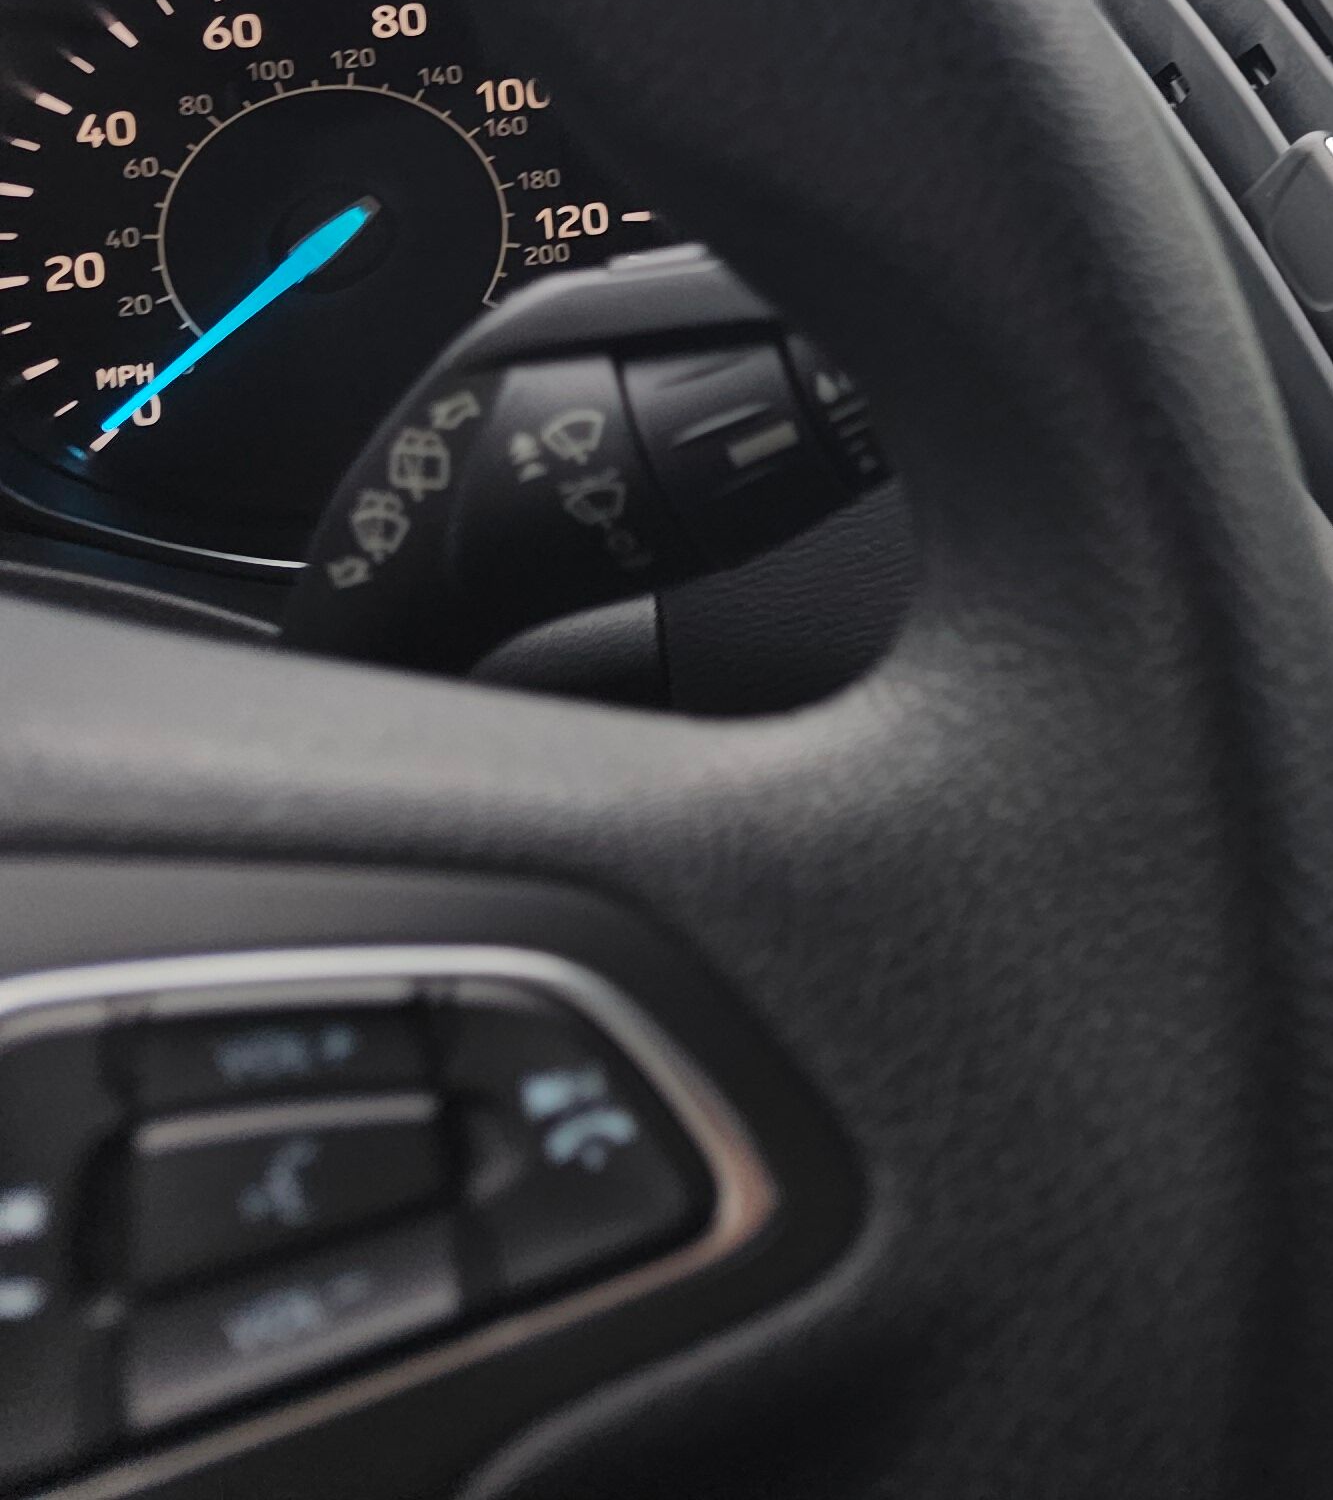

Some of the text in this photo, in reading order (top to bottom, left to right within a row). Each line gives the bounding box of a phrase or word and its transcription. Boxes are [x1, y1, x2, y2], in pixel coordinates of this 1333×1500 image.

[202, 12, 262, 49] 60
[371, 2, 427, 38] 80
[246, 58, 295, 81] 100
[331, 47, 376, 70] 120
[417, 64, 463, 87] 140
[179, 94, 213, 117] 80
[76, 111, 136, 148] 40
[484, 116, 528, 138] 160
[123, 157, 159, 178] 60
[516, 168, 562, 190] 180
[535, 202, 609, 240] 120
[105, 227, 140, 248] 40
[523, 244, 571, 266] 200
[44, 252, 105, 291] 20
[118, 295, 153, 316] 20
[95, 362, 154, 391] MPH
